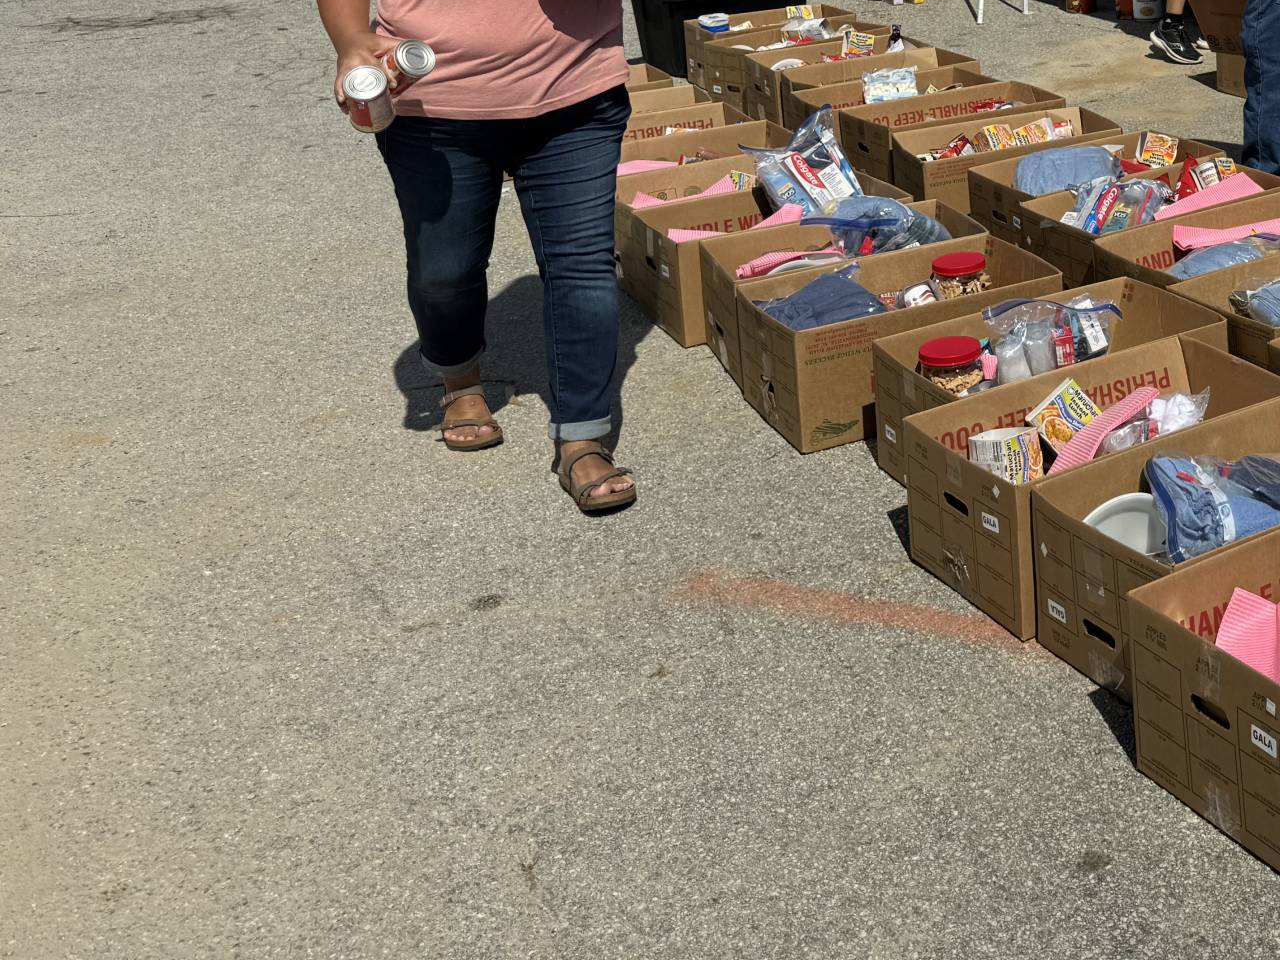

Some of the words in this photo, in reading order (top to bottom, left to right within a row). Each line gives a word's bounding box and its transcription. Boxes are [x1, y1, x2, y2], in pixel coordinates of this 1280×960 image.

[793, 153, 819, 185] Colgate
[1097, 187, 1118, 220] Colgate
[982, 514, 997, 529] GALA
[1253, 729, 1274, 751] GALA
